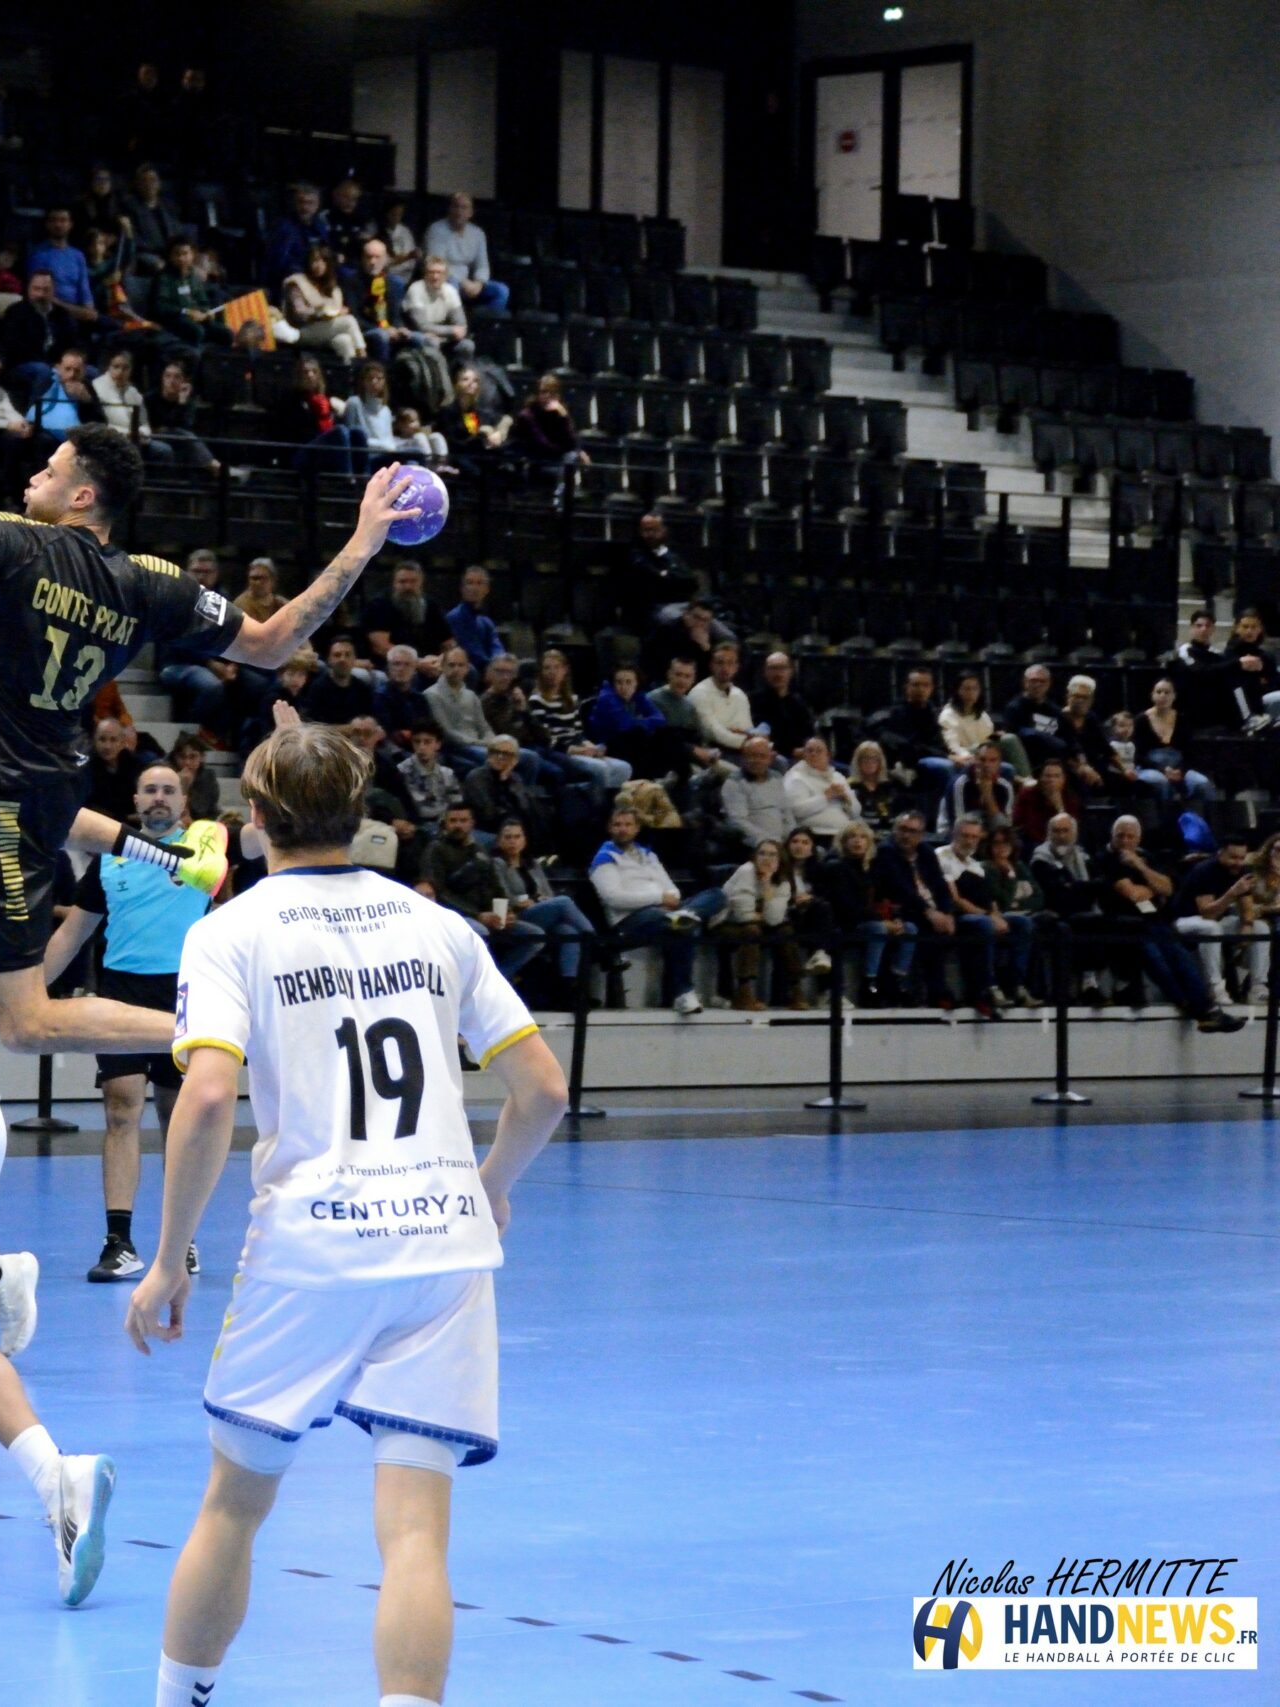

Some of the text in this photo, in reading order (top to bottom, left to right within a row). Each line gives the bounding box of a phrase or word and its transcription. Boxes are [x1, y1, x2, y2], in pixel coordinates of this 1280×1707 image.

[32, 577, 138, 646] CONTE PRAT
[30, 624, 105, 711] 13
[358, 958, 445, 1000] HANDBLL
[335, 1016, 424, 1141] 19
[310, 1194, 449, 1221] CENTURY
